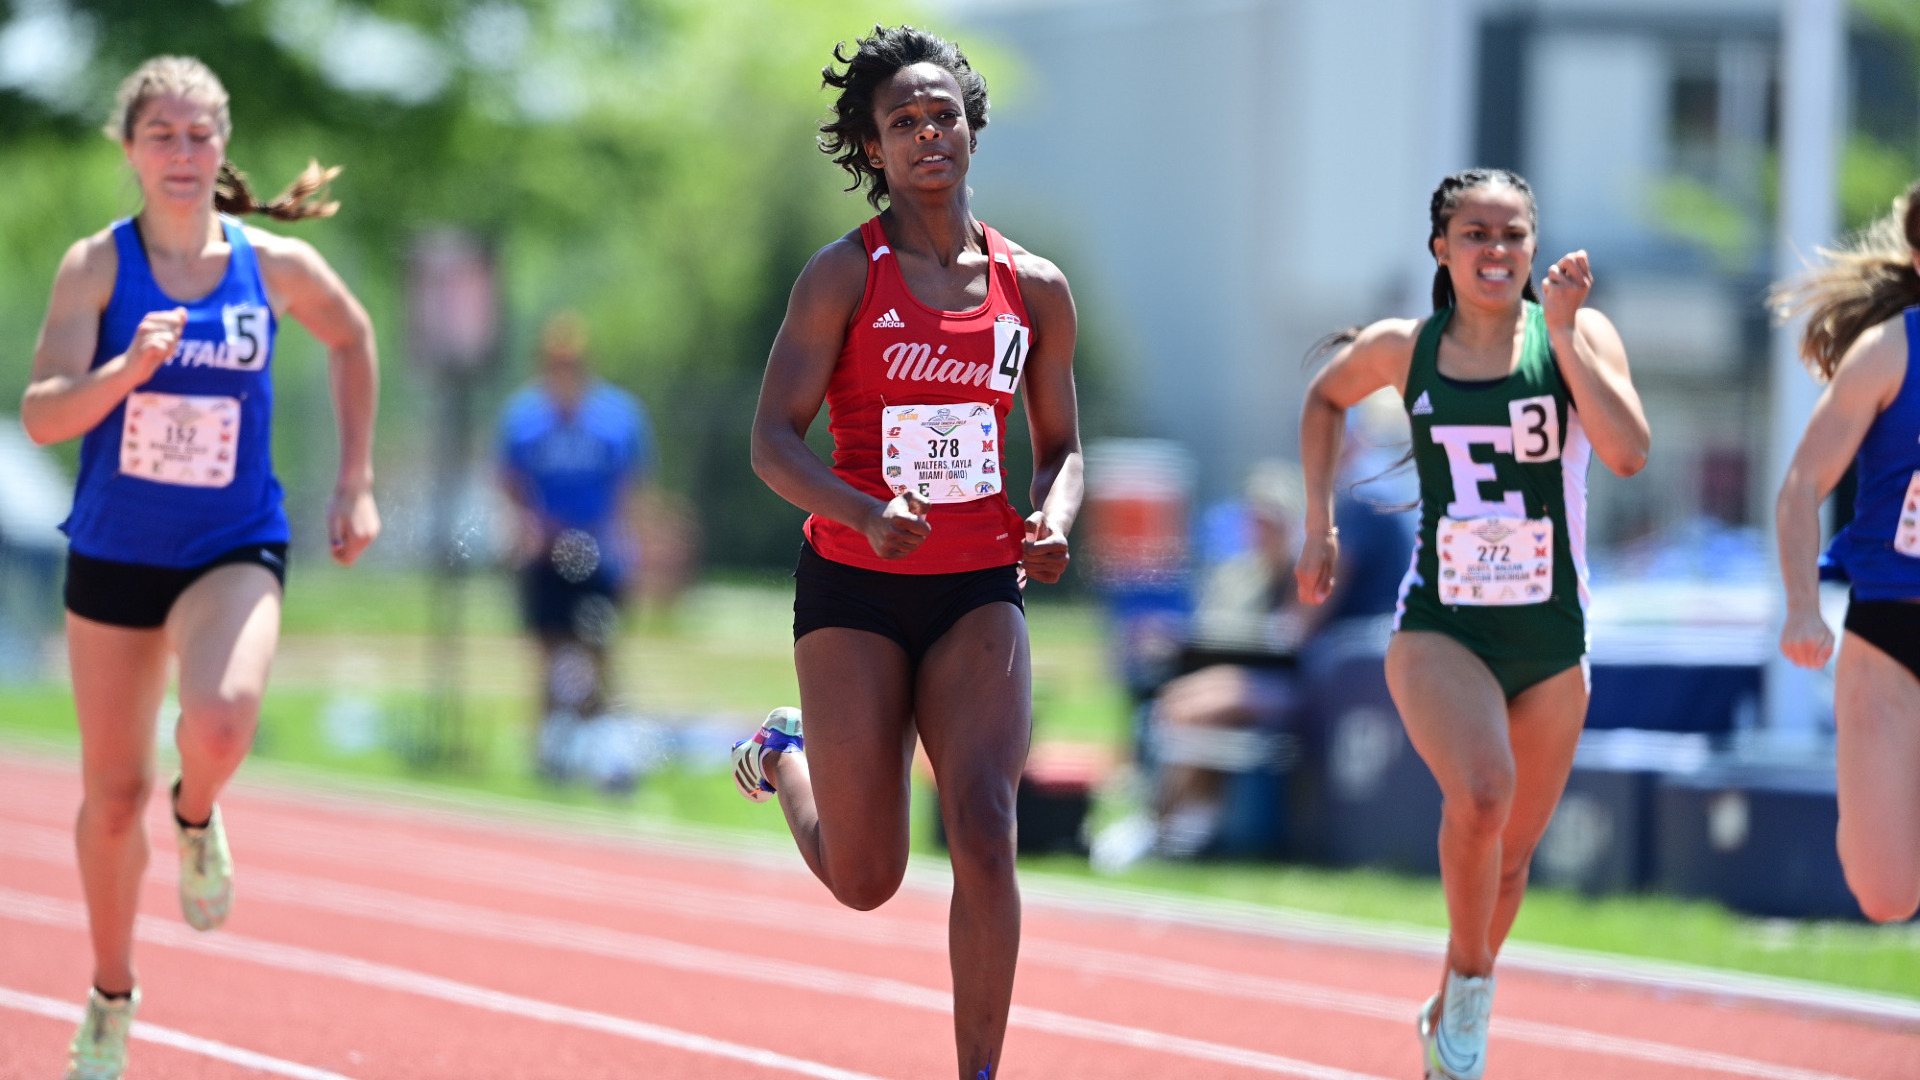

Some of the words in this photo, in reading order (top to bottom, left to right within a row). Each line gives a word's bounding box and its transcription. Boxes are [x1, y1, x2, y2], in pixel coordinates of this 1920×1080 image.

[237, 314, 258, 365] 5
[873, 320, 905, 328] adidas
[882, 342, 992, 389] Miam
[999, 329, 1020, 390] 4
[928, 439, 959, 458] 378
[1522, 404, 1548, 457] 3
[919, 470, 943, 480] MIAMI
[1430, 425, 1526, 519] E
[1477, 545, 1510, 562] 272
